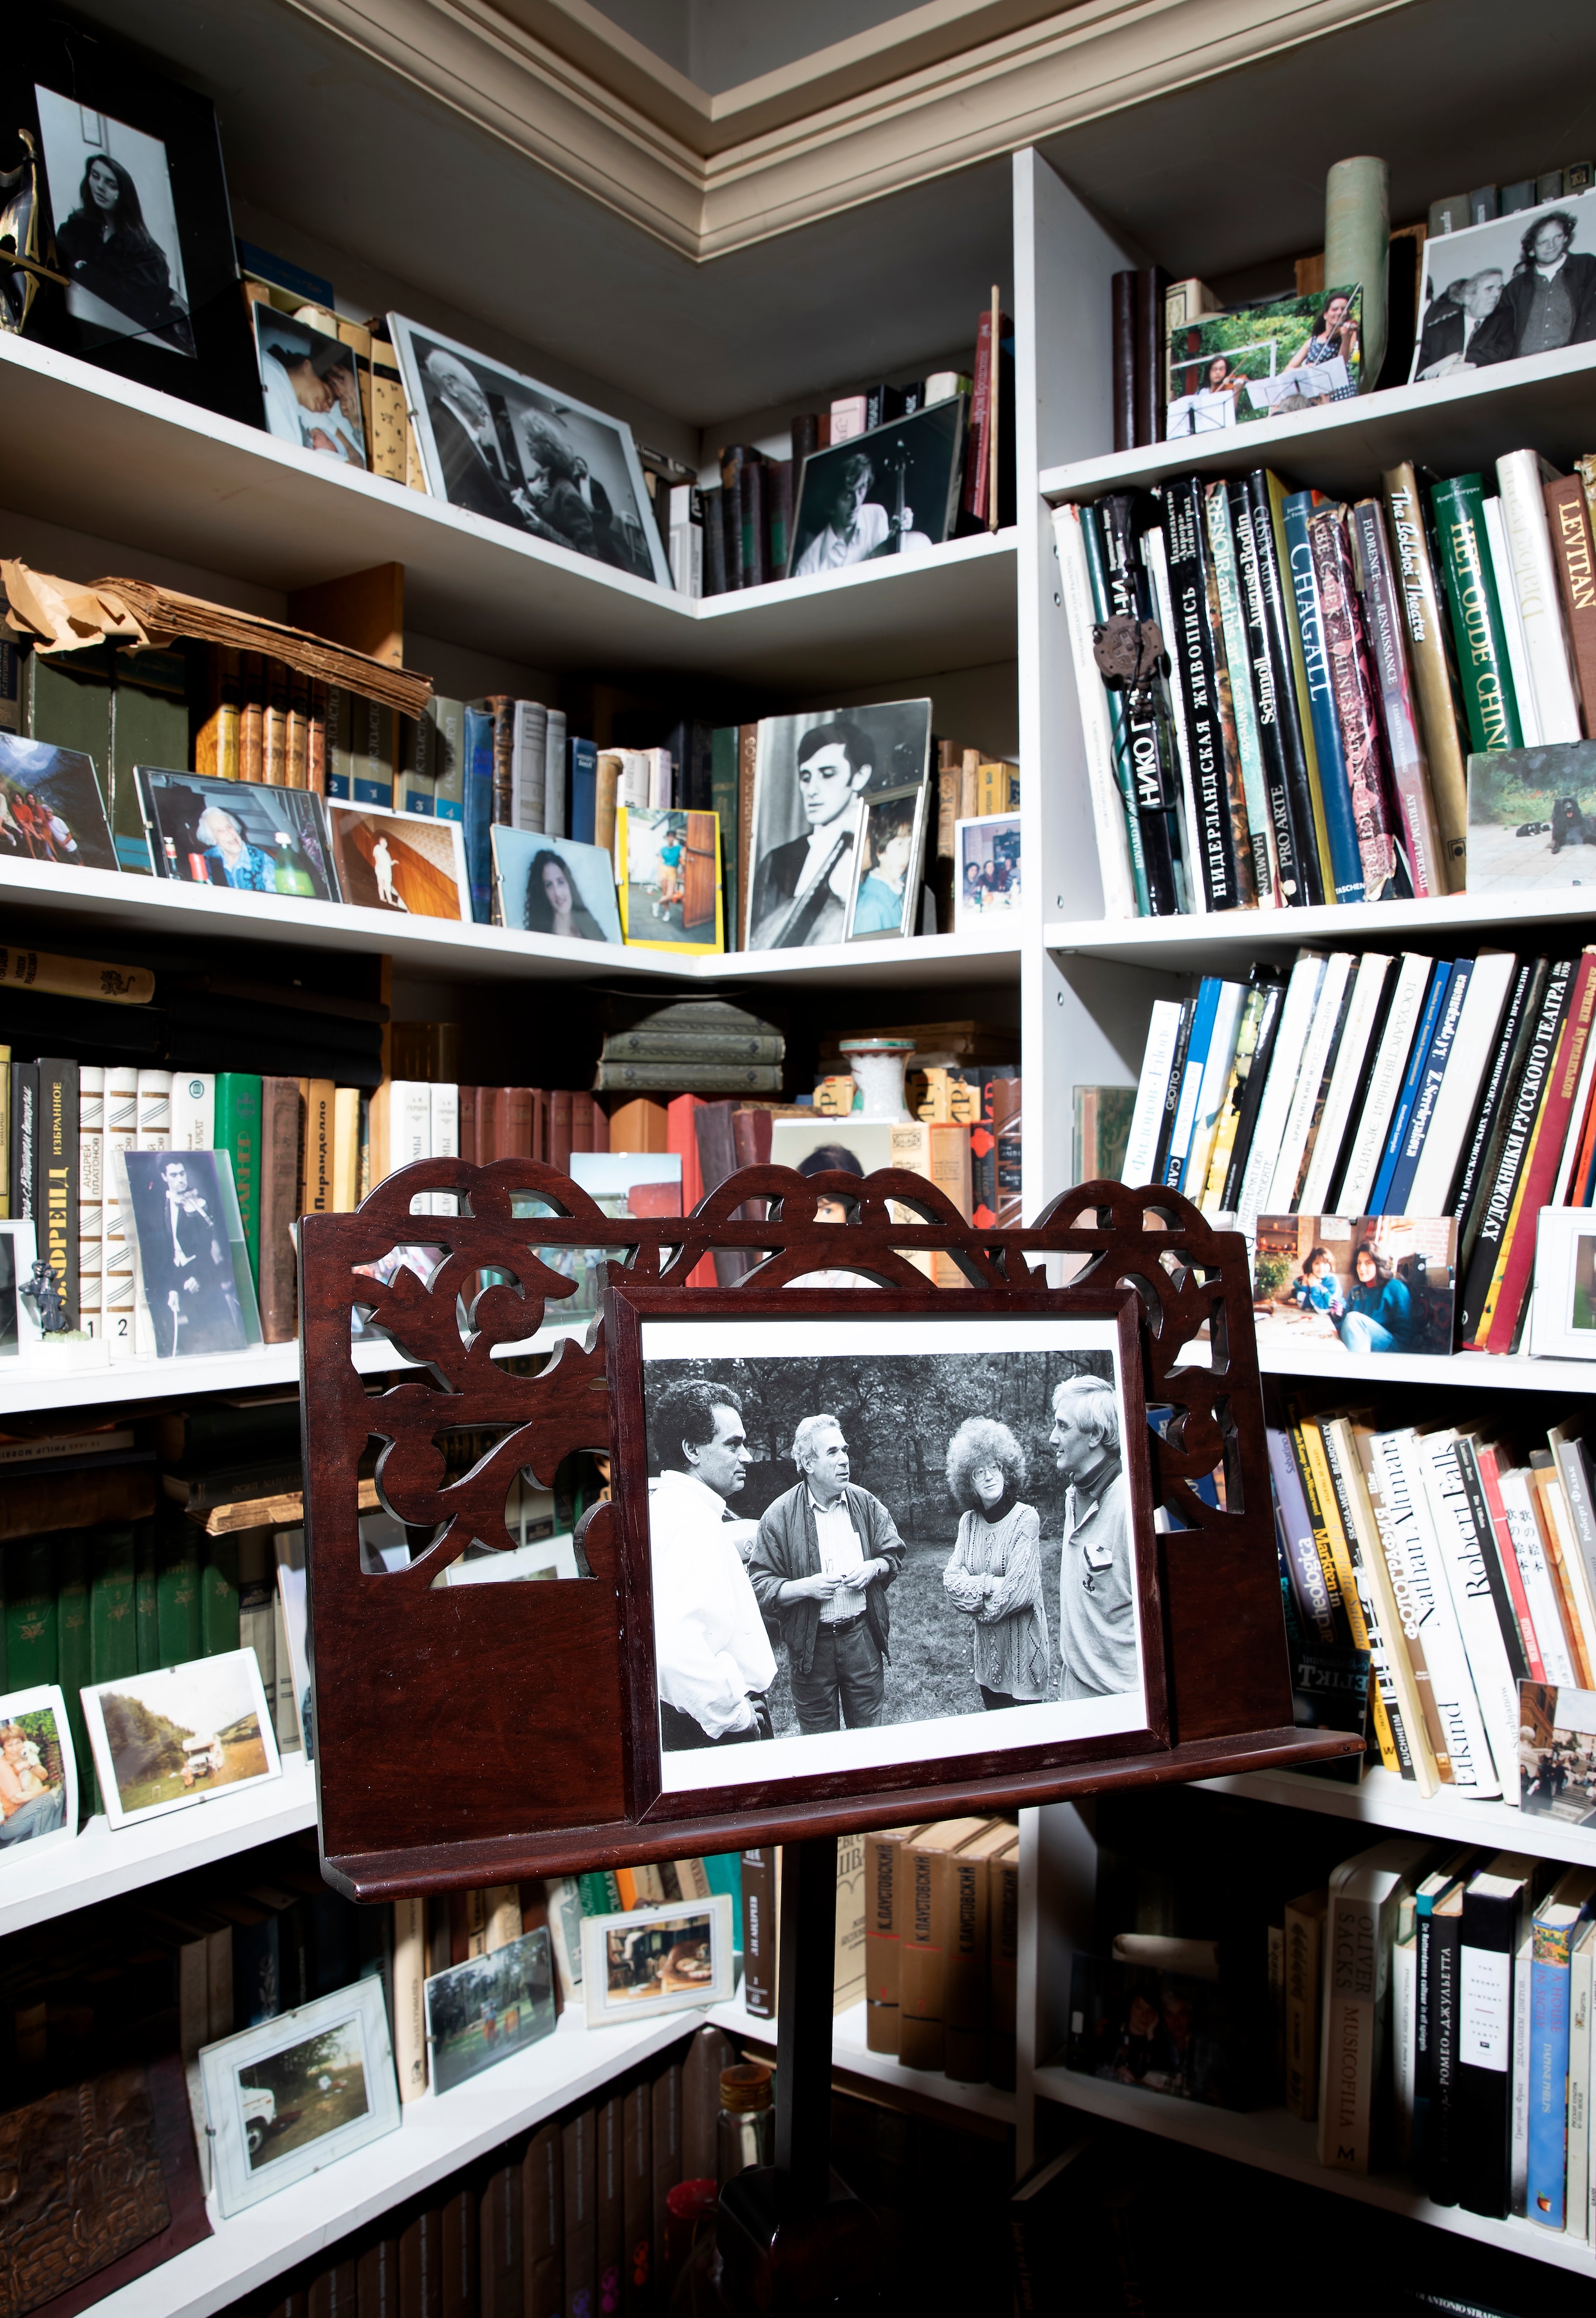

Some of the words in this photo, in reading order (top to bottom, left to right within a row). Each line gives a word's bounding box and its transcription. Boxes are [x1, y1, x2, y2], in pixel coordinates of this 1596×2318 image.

[1164, 491, 1180, 565] Издательство
[1182, 496, 1198, 558] Ленинград
[1389, 485, 1415, 519] The
[1205, 498, 1232, 573] RENOIR
[1234, 512, 1255, 565] Rodin
[1251, 505, 1275, 557] GUSTAV
[1395, 518, 1422, 577] Bolshoi
[1449, 518, 1481, 577] HET
[1556, 498, 1596, 610] LEVITAN
[1216, 575, 1236, 612] and
[1240, 562, 1264, 629] Auguste
[1361, 518, 1383, 582] FLORENCE
[1375, 603, 1399, 684] RENAISSANCE
[1508, 536, 1546, 620] Dialog
[1221, 611, 1240, 640] his
[1288, 542, 1332, 702] CHAGALL
[1404, 577, 1431, 642] Theatre
[1459, 584, 1496, 665] OUDE
[1178, 586, 1209, 709] ЖИВОПИСЬ
[1225, 640, 1244, 668] art
[1230, 677, 1247, 711] Keith
[1250, 656, 1277, 725] Schmoll
[1331, 642, 1357, 725] CHINESE
[742, 735, 756, 774] СЛОВ
[1234, 709, 1254, 762] Wheldon
[329, 781, 339, 792] 2
[369, 789, 378, 799] 1
[1129, 734, 1164, 806] НИКО
[416, 800, 423, 812] 3
[445, 808, 454, 818] 4
[1124, 789, 1138, 828] MUNCH
[1193, 719, 1230, 897] НИДЕРЛАНДСКАЯ
[1270, 784, 1290, 830] ARTE
[1129, 828, 1145, 868] EDVARD
[1250, 836, 1270, 894] HAMLYN
[1276, 830, 1294, 868] PRO
[1404, 793, 1429, 892] ATRIUM/TERRAIL
[1334, 881, 1366, 895] TASCHEN
[14, 955, 26, 979] ЭПОХИ
[1508, 965, 1530, 1017] ВРЕМЕНИ
[1370, 981, 1418, 1117] ГОСУДАРСТВЕННЫЙ
[1503, 1018, 1516, 1040] ЕГО
[1164, 1069, 1181, 1111] GIOTTO
[1482, 1040, 1510, 1116] ХУДОЖНИКОВ
[51, 1082, 62, 1155] ИЗБРАННОЕ
[1173, 1065, 1198, 1152] REMBRANDT
[1290, 1080, 1313, 1141] БРИТАНСКИЙ
[1480, 1132, 1528, 1242] ХУДОЖНИКИ
[1510, 1043, 1550, 1134] РУССКОГО
[1534, 977, 1568, 1044] ТЕАТРА
[80, 1145, 91, 1187] АНДРЕЙ
[313, 1100, 328, 1210] Пиранделло
[1350, 1121, 1380, 1195] ЭРМИТАЖ
[1461, 1116, 1489, 1190] МОСКОВСКИХ
[1238, 1171, 1259, 1228] TREFFPUNKT
[1252, 1149, 1265, 1169] DER
[1460, 1191, 1469, 1200] И
[88, 1321, 94, 1338] 1
[118, 1318, 128, 1337] 2
[0, 1448, 32, 1459] MORRI
[35, 1444, 66, 1454] PHILIP
[1279, 1437, 1295, 1474] Sabatino
[1321, 1423, 1341, 1475] BEARDSLEY
[1429, 1442, 1467, 1501] Falk
[1334, 1477, 1357, 1540] SKASA-WEISS
[1378, 1437, 1418, 1535] Altman
[1564, 1464, 1582, 1504] Фальк
[1312, 1526, 1340, 1591] Markten
[1328, 1591, 1344, 1607] in
[1373, 1504, 1420, 1642] ФОТОГРАФИЯ
[1445, 1503, 1491, 1600] Robert
[1292, 1535, 1339, 1645] archeologica
[1328, 1523, 1355, 1594] Charlotte
[1346, 1596, 1370, 1649] Salomo
[1398, 1537, 1440, 1630] Nathan
[1391, 1713, 1412, 1767] BUCHHEIM
[1439, 1701, 1478, 1790] Etkind
[1335, 1911, 1355, 1989] SACKS
[1355, 1914, 1373, 1994] OLIVER
[1421, 1922, 1429, 1932] De
[1420, 1932, 1429, 1977] Rotterdamse
[1536, 1968, 1546, 1984] IN
[1551, 1973, 1562, 1982] A
[1420, 1979, 1428, 2005] cultuur
[1440, 1947, 1452, 2029] ДЖУЛЬЕТТА
[1534, 1988, 1545, 2028] SICILY
[1550, 1987, 1562, 2033] HOUSE
[1418, 2024, 1427, 2052] spiegels
[1419, 2014, 1427, 2023] elf
[1339, 2005, 1359, 2128] MUSICOFILIA
[1438, 2039, 1451, 2086] РОМЕО
[1541, 2043, 1552, 2080] DAPHNE
[1426, 2294, 1467, 2313] ANTONIO
